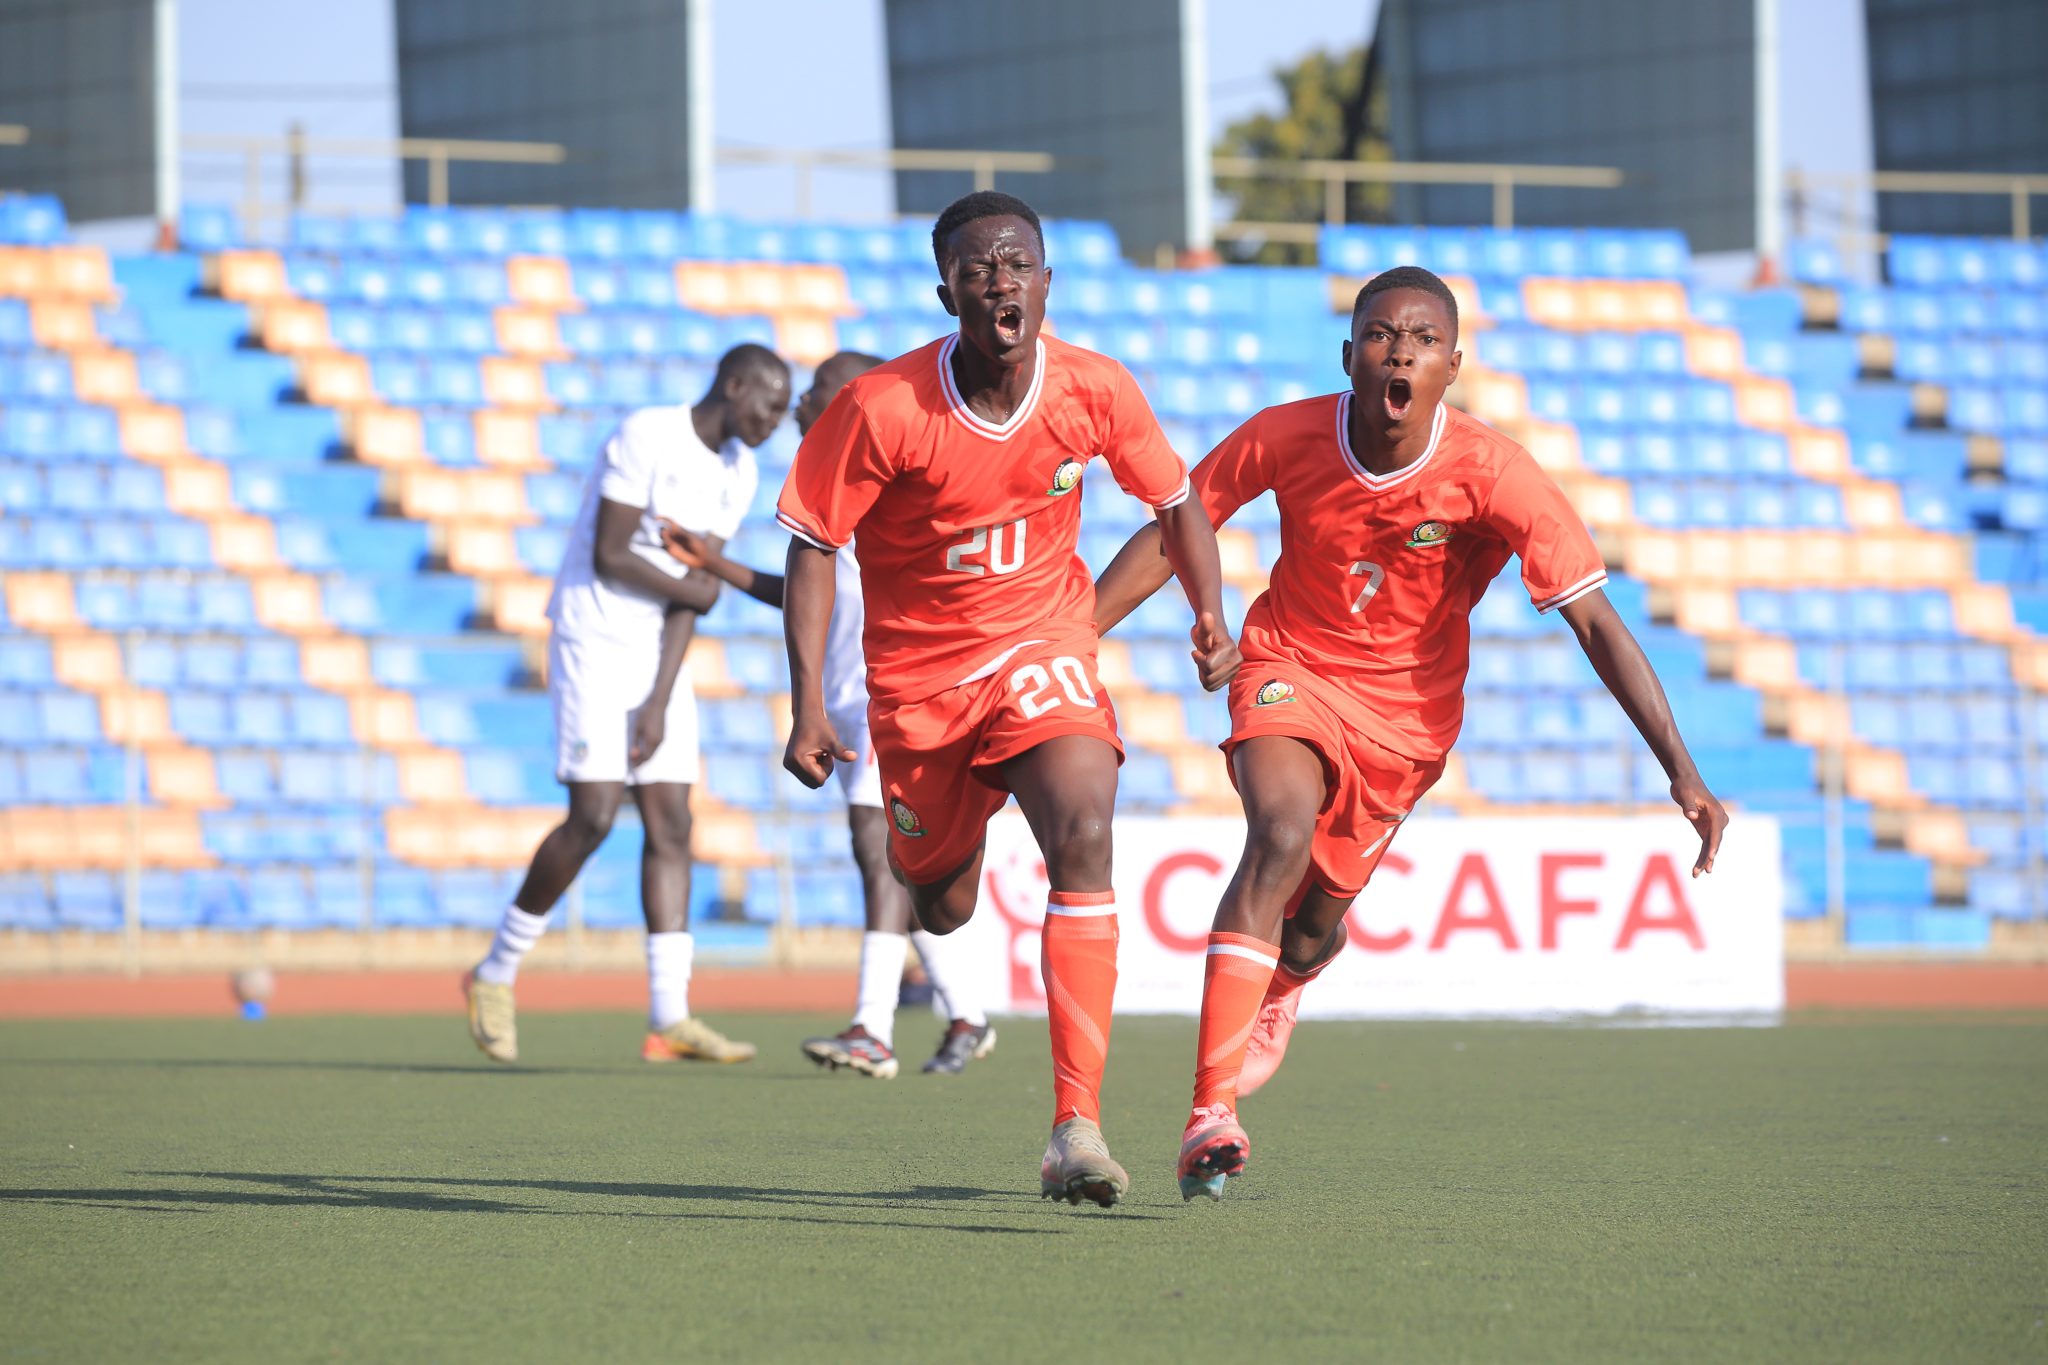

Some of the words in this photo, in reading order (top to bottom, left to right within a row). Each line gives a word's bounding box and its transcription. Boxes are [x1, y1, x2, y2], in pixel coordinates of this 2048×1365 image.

[947, 517, 1027, 575] 20
[1349, 560, 1385, 614] 7
[1010, 656, 1097, 720] 20
[1142, 850, 1706, 952] CCAFA
